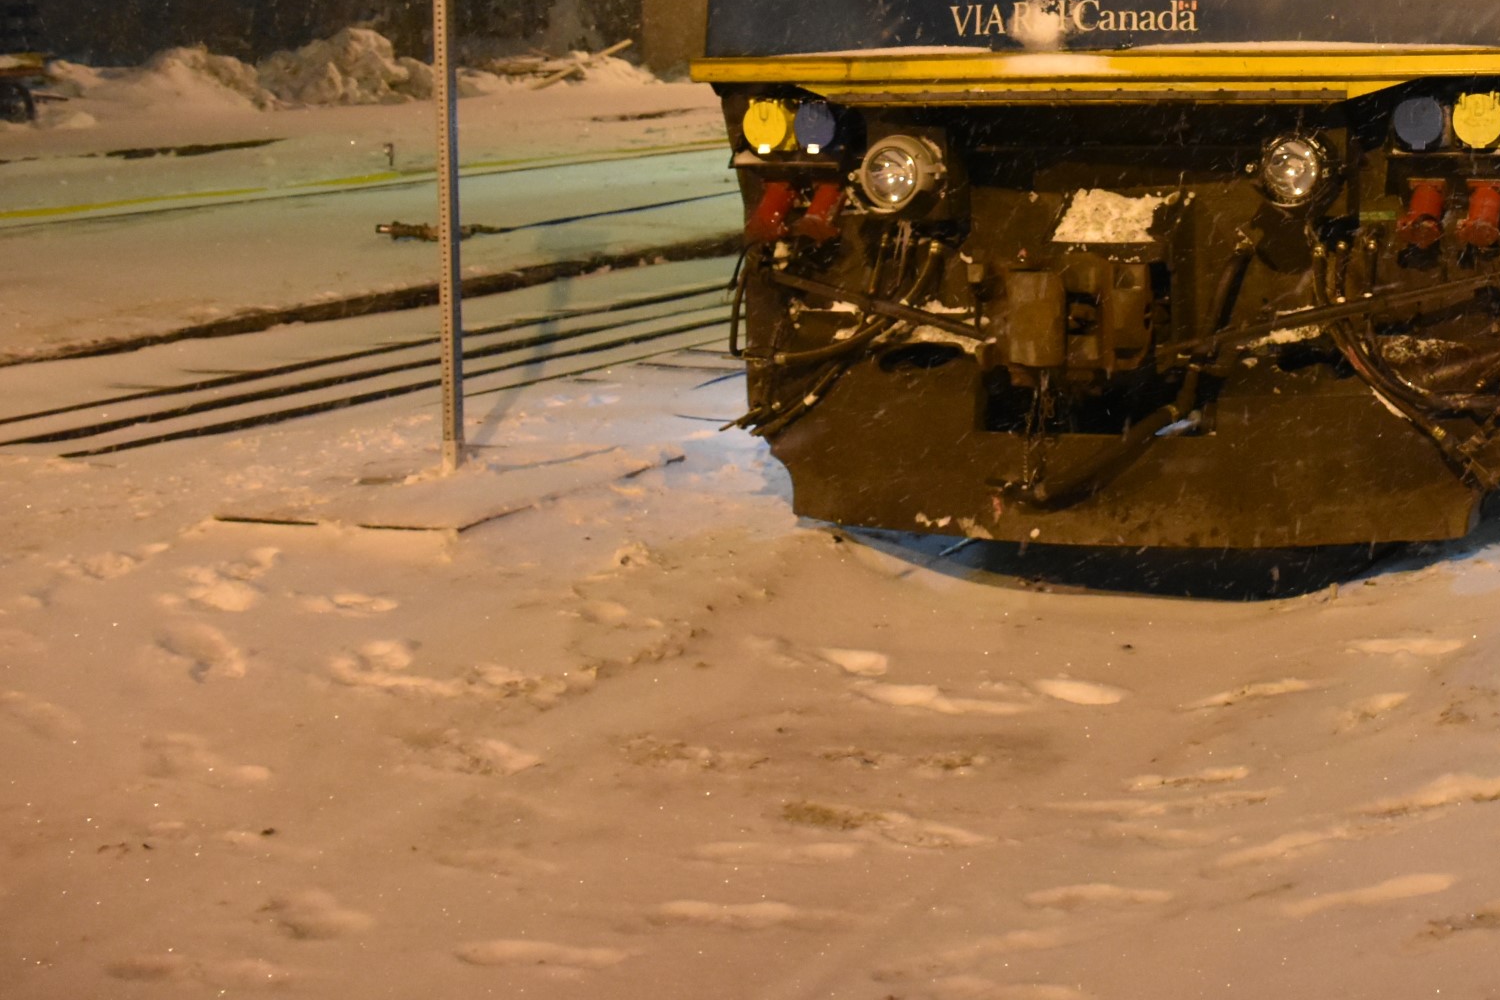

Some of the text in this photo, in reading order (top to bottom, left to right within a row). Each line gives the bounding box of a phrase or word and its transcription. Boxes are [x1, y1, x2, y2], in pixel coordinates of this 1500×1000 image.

[950, 0, 1198, 37] VIA Rl Canada
